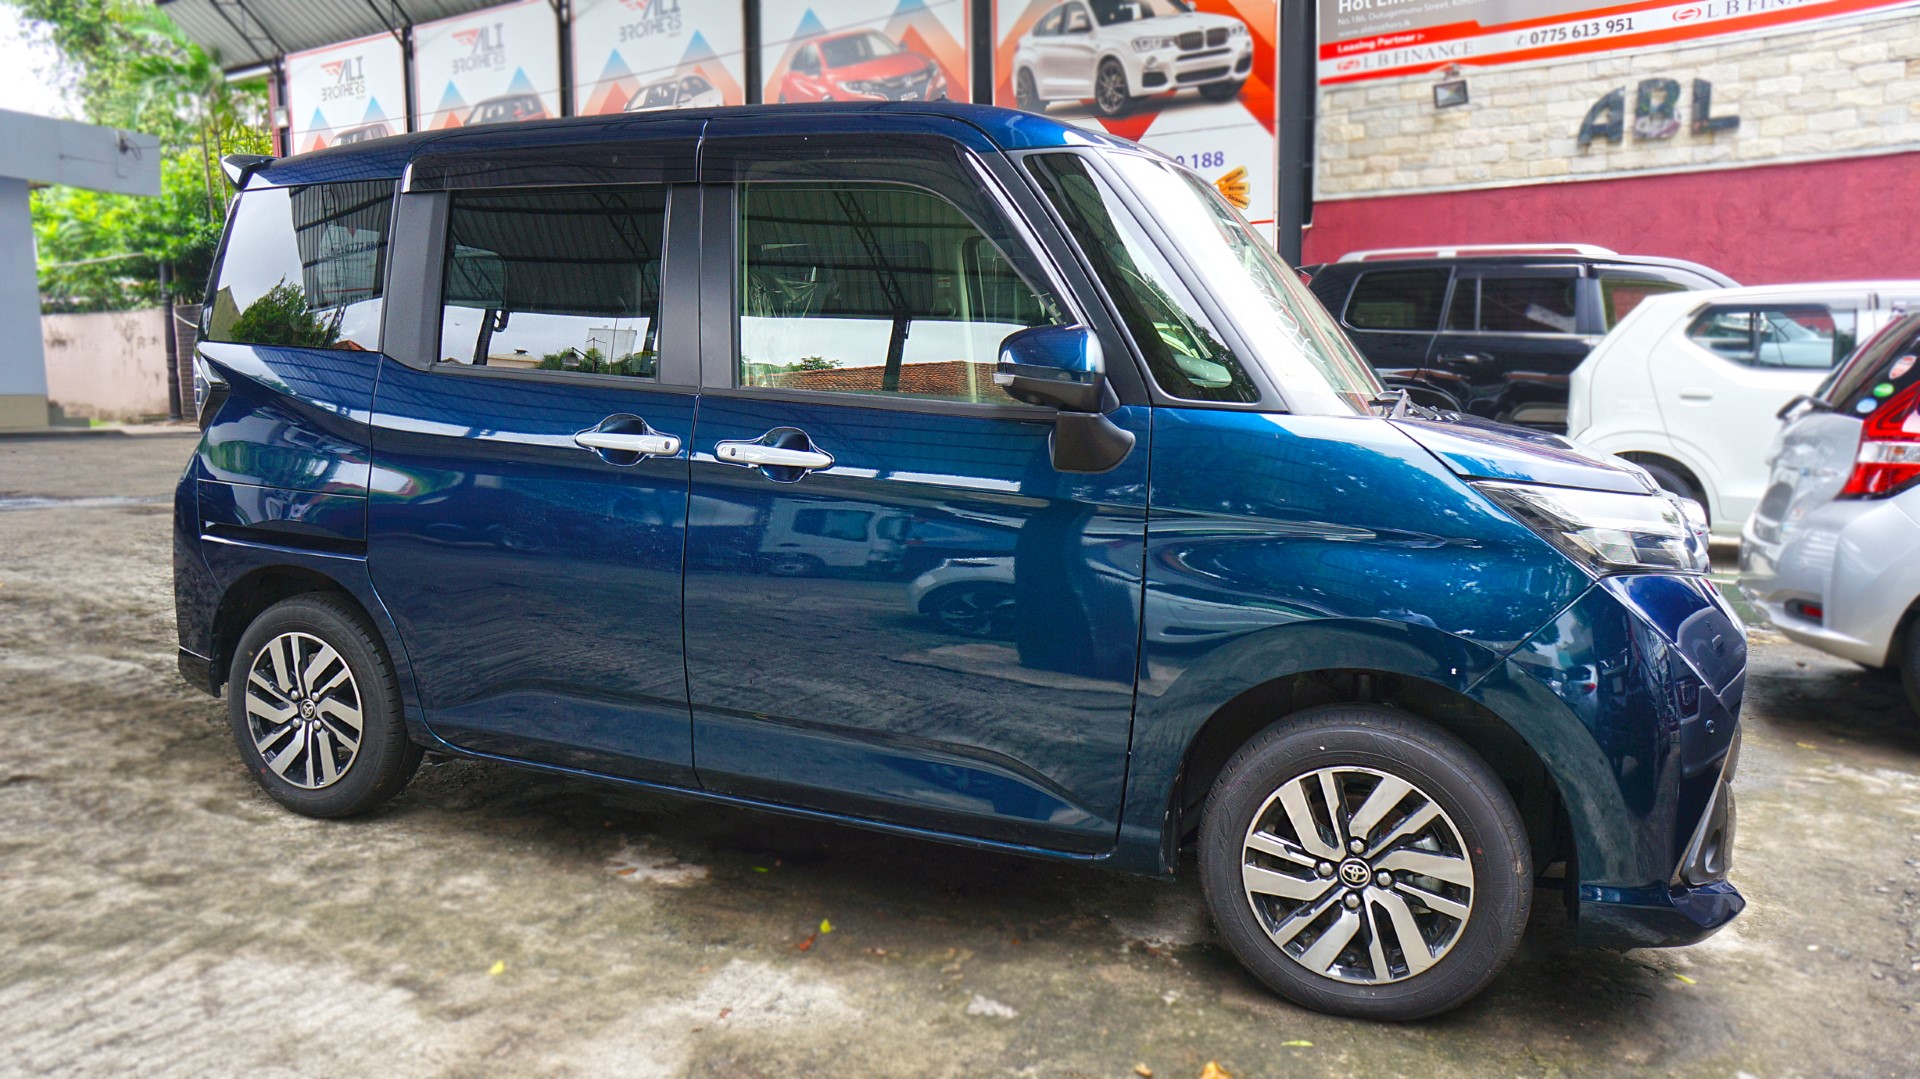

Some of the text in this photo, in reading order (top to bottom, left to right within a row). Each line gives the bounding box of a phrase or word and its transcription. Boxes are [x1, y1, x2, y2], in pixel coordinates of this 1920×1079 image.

[1530, 17, 1634, 45] 0775 613 951
[1337, 34, 1416, 54] Leasing Partner
[1394, 40, 1474, 65] FINANCE
[1577, 77, 1741, 147] ABL
[1191, 151, 1225, 169] 188
